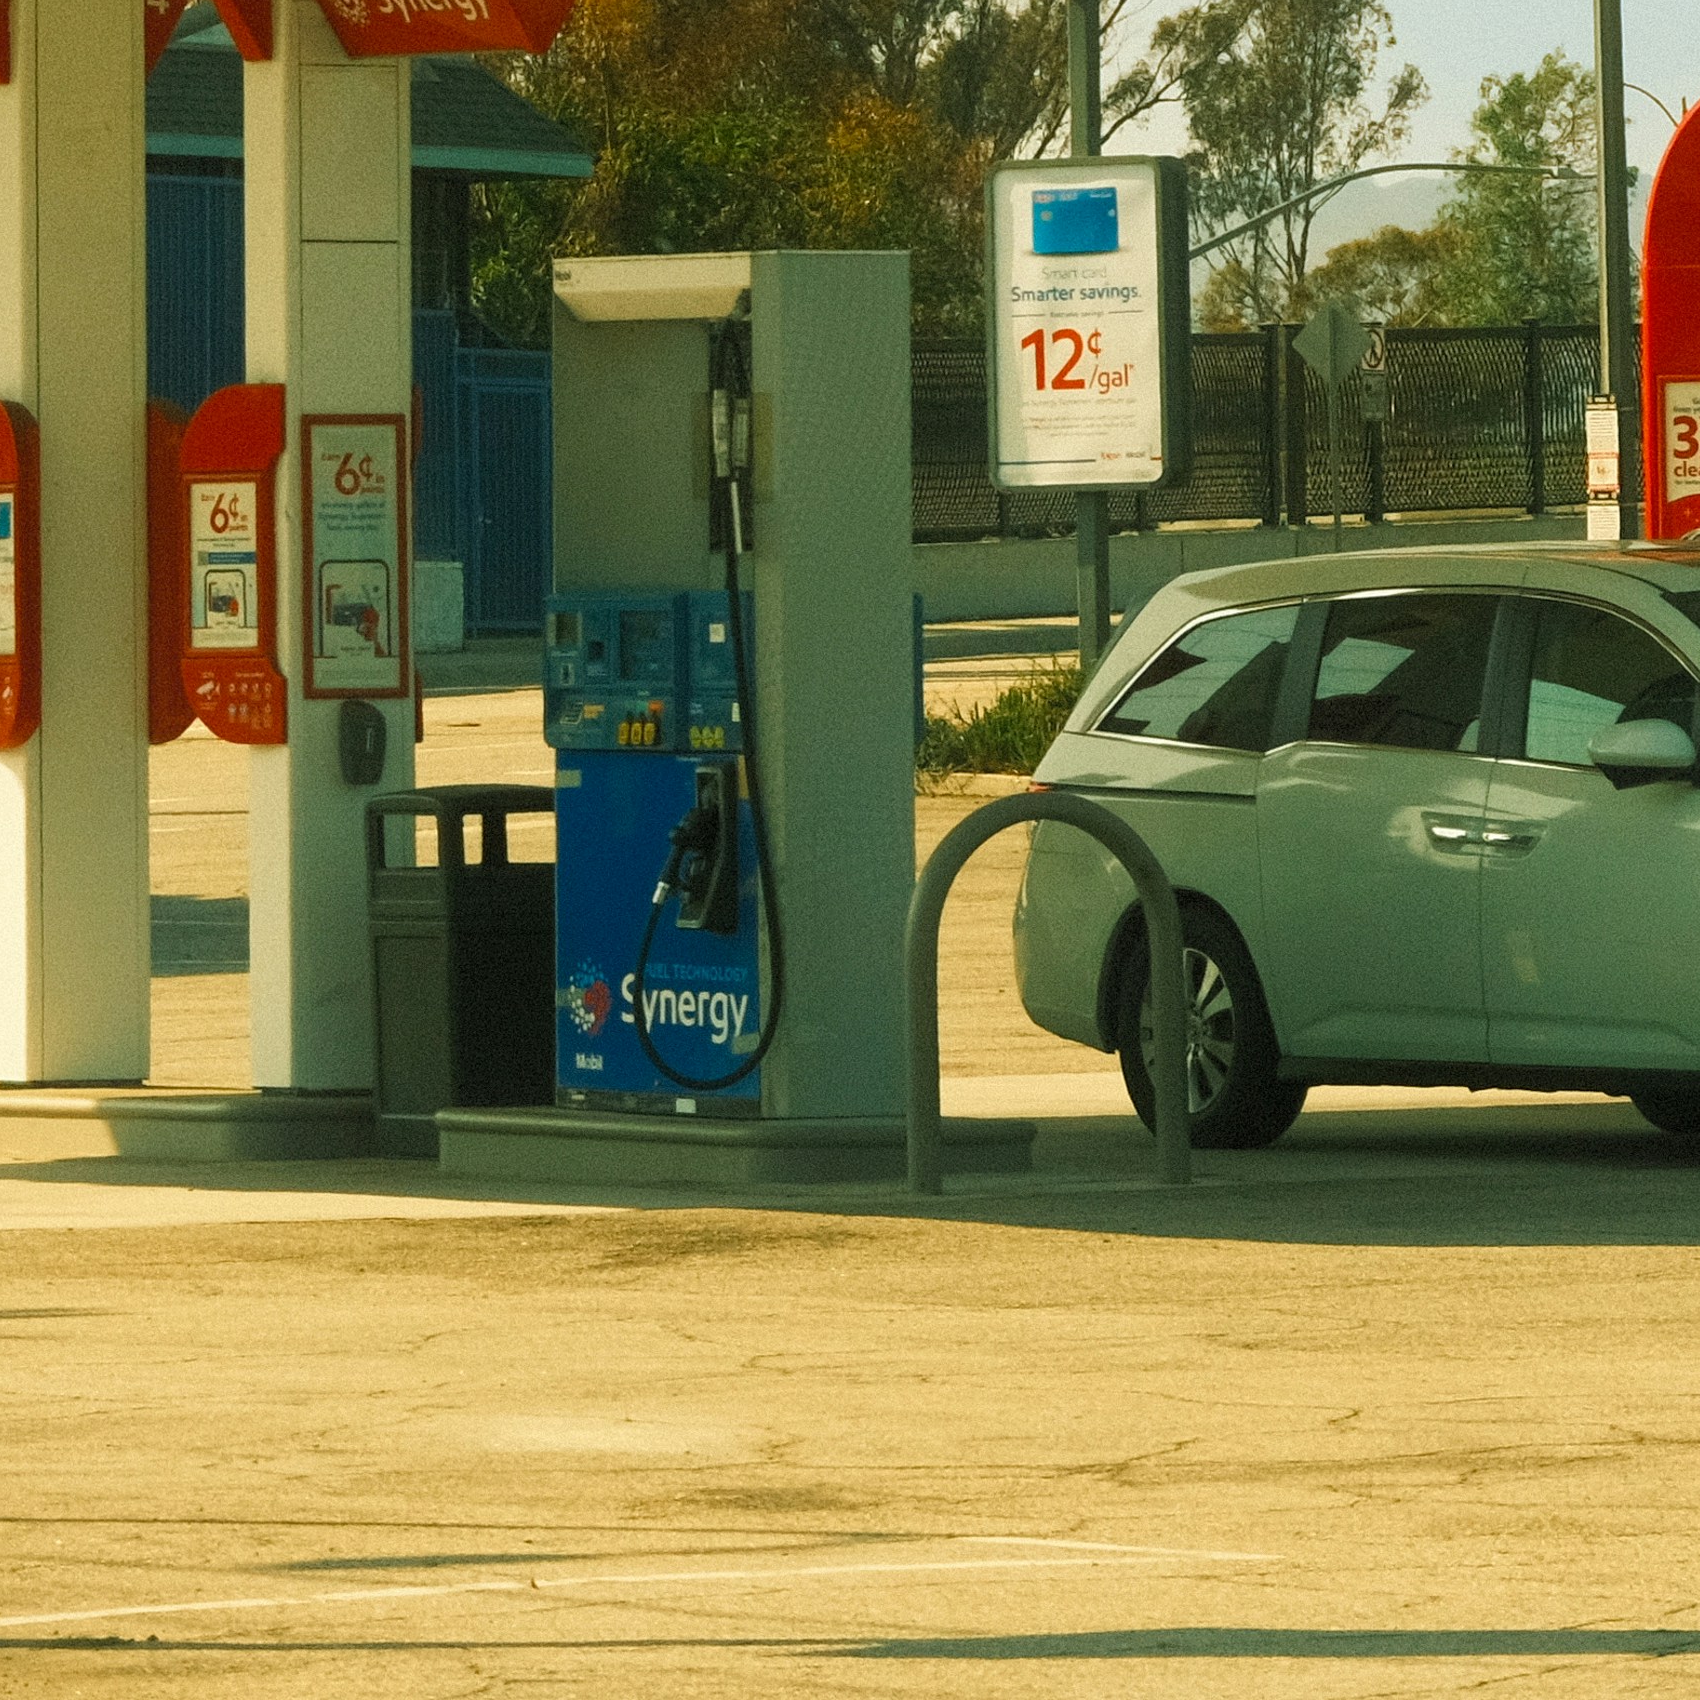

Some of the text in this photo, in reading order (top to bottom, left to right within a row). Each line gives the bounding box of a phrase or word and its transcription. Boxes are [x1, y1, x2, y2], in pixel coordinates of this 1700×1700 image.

[1011, 286, 1075, 302] Smarter
[673, 964, 749, 982] TECHNOLOGY
[620, 972, 749, 1045] Synergy
